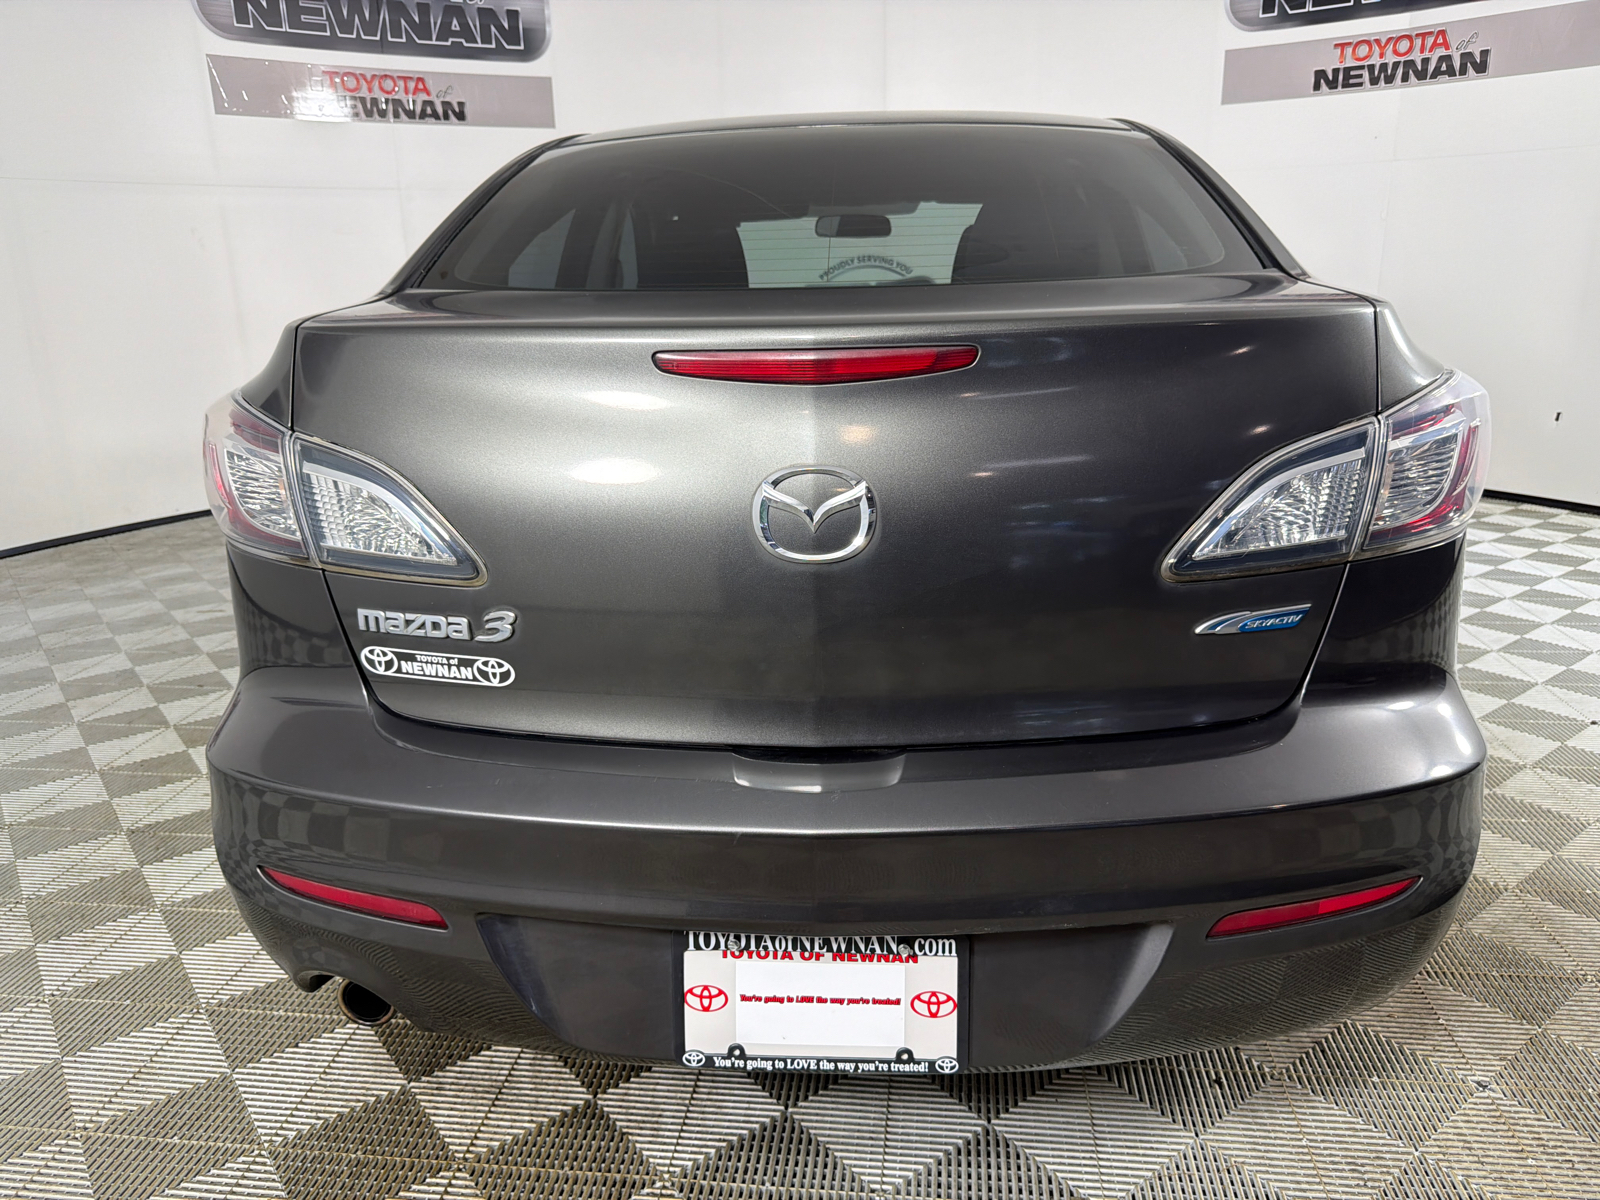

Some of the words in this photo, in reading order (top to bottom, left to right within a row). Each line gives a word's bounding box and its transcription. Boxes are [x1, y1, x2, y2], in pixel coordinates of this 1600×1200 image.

[231, 0, 524, 50] NEWNAN
[1333, 28, 1450, 64] TOYOTA
[1456, 32, 1479, 51] of
[1312, 48, 1491, 92] NEWNAN
[322, 70, 431, 97] TOYOTA
[436, 85, 453, 99] of
[818, 256, 855, 281] PROUDLY
[857, 255, 894, 267] SERVING
[896, 260, 913, 275] YOU
[474, 611, 516, 642] 3
[1245, 614, 1303, 628] SKYACTIV
[400, 660, 473, 680] NEWNAN
[415, 655, 448, 665] TOYOTA
[740, 994, 762, 1003] You're
[764, 995, 785, 1004] going
[786, 995, 794, 1003] to
[796, 995, 814, 1003] LOVE
[846, 997, 870, 1006] you're
[713, 1057, 744, 1068] You're
[746, 1058, 772, 1071] going
[775, 1059, 784, 1069] to
[786, 1059, 817, 1070] LOVE
[819, 1060, 835, 1070] the
[837, 1062, 856, 1072] way
[857, 1060, 888, 1072] you're
[890, 1061, 928, 1072] treated!
